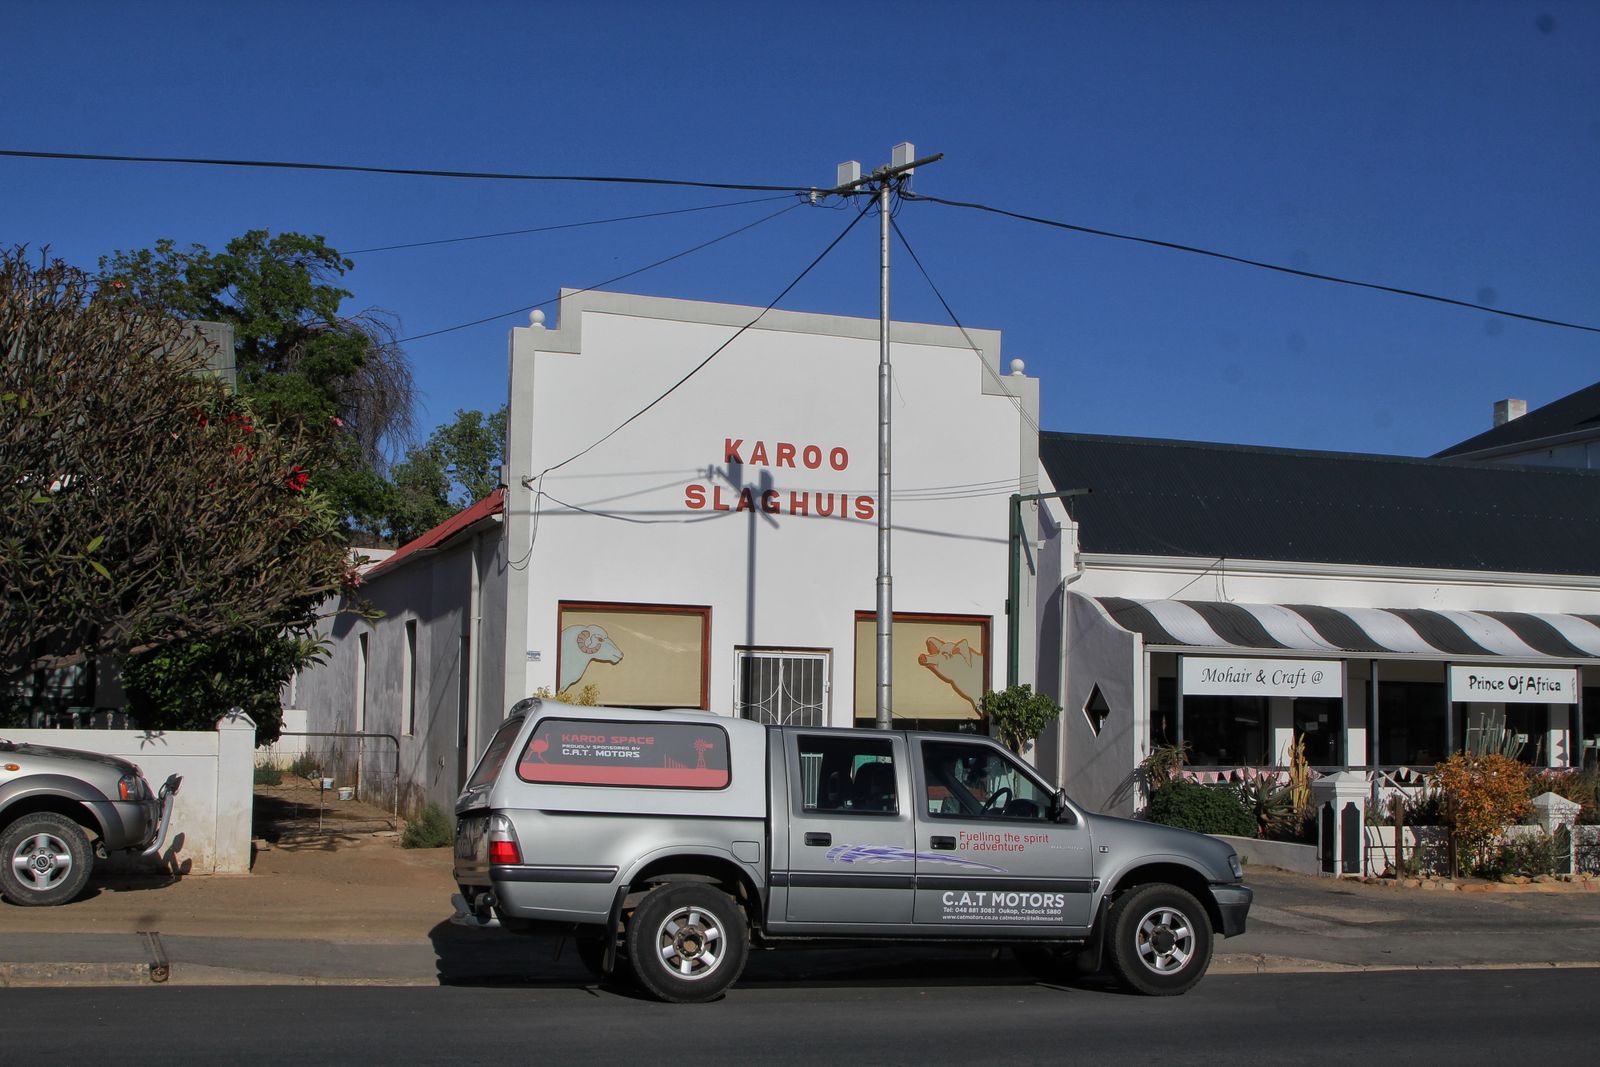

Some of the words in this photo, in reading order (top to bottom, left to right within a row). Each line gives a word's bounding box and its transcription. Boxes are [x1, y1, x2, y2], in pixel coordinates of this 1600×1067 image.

[724, 438, 849, 471] KAROO
[685, 484, 875, 519] SLAGHUIS
[1201, 666, 1252, 684] Mohair
[1255, 669, 1266, 684] &
[1272, 668, 1306, 689] Craft
[1311, 670, 1324, 685] @
[1468, 675, 1505, 691] Prince
[1508, 675, 1524, 694] Of
[1526, 676, 1561, 695] Africa
[561, 734, 605, 743] KAROO
[611, 735, 655, 745] SPACE
[562, 748, 592, 757] C.A.T.
[595, 750, 640, 758] MOTORS
[959, 831, 1000, 844] Fuelling
[1005, 833, 1020, 842] the
[1024, 834, 1049, 844] spirit
[960, 841, 969, 850] of
[973, 842, 1025, 852] adventure
[942, 891, 987, 906] C.A.T
[991, 892, 1065, 908] MOTORS
